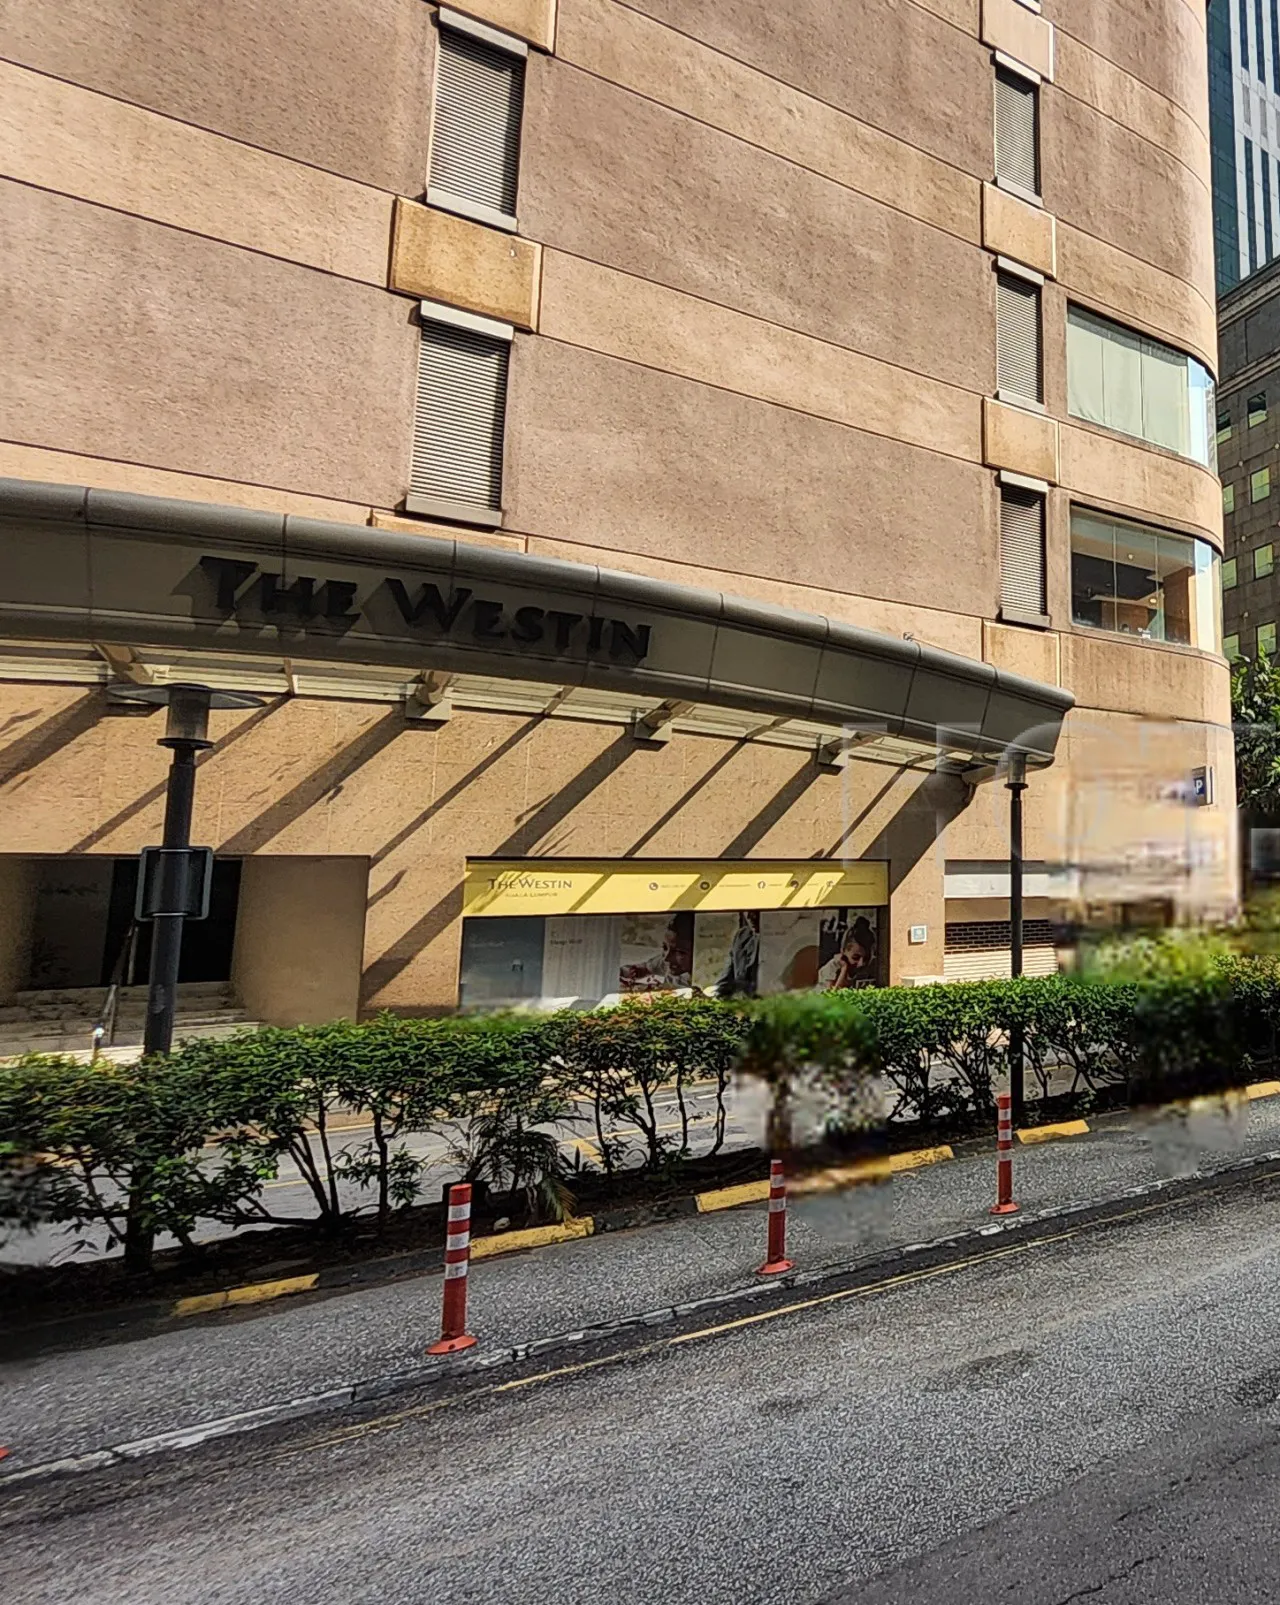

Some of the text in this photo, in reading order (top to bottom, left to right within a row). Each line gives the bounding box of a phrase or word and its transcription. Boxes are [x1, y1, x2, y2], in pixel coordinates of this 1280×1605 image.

[199, 555, 652, 664] THE WESTIN
[487, 878, 573, 890] THE WESTIN
